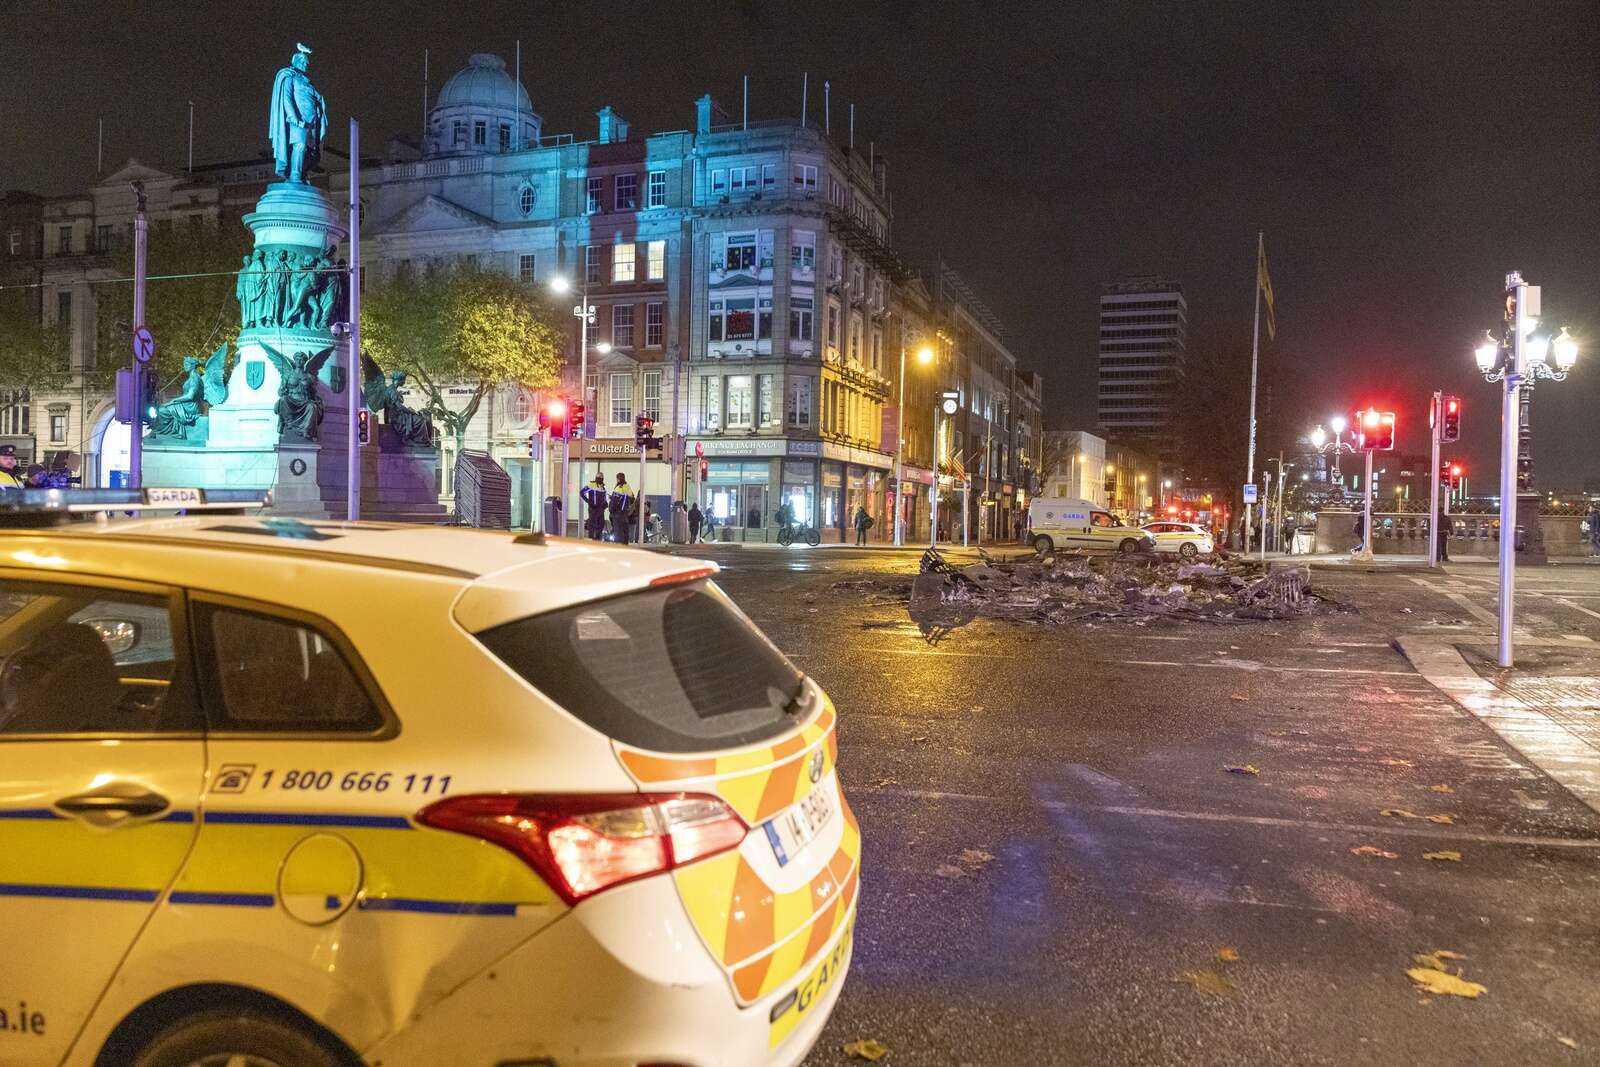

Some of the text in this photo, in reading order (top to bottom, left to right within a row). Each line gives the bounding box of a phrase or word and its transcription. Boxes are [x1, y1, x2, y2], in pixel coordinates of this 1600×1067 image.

[597, 444, 640, 454] Ulster Ba
[736, 440, 777, 449] EXCHANGE
[150, 490, 198, 502] GARDA
[260, 769, 451, 794] 1 800 666 111
